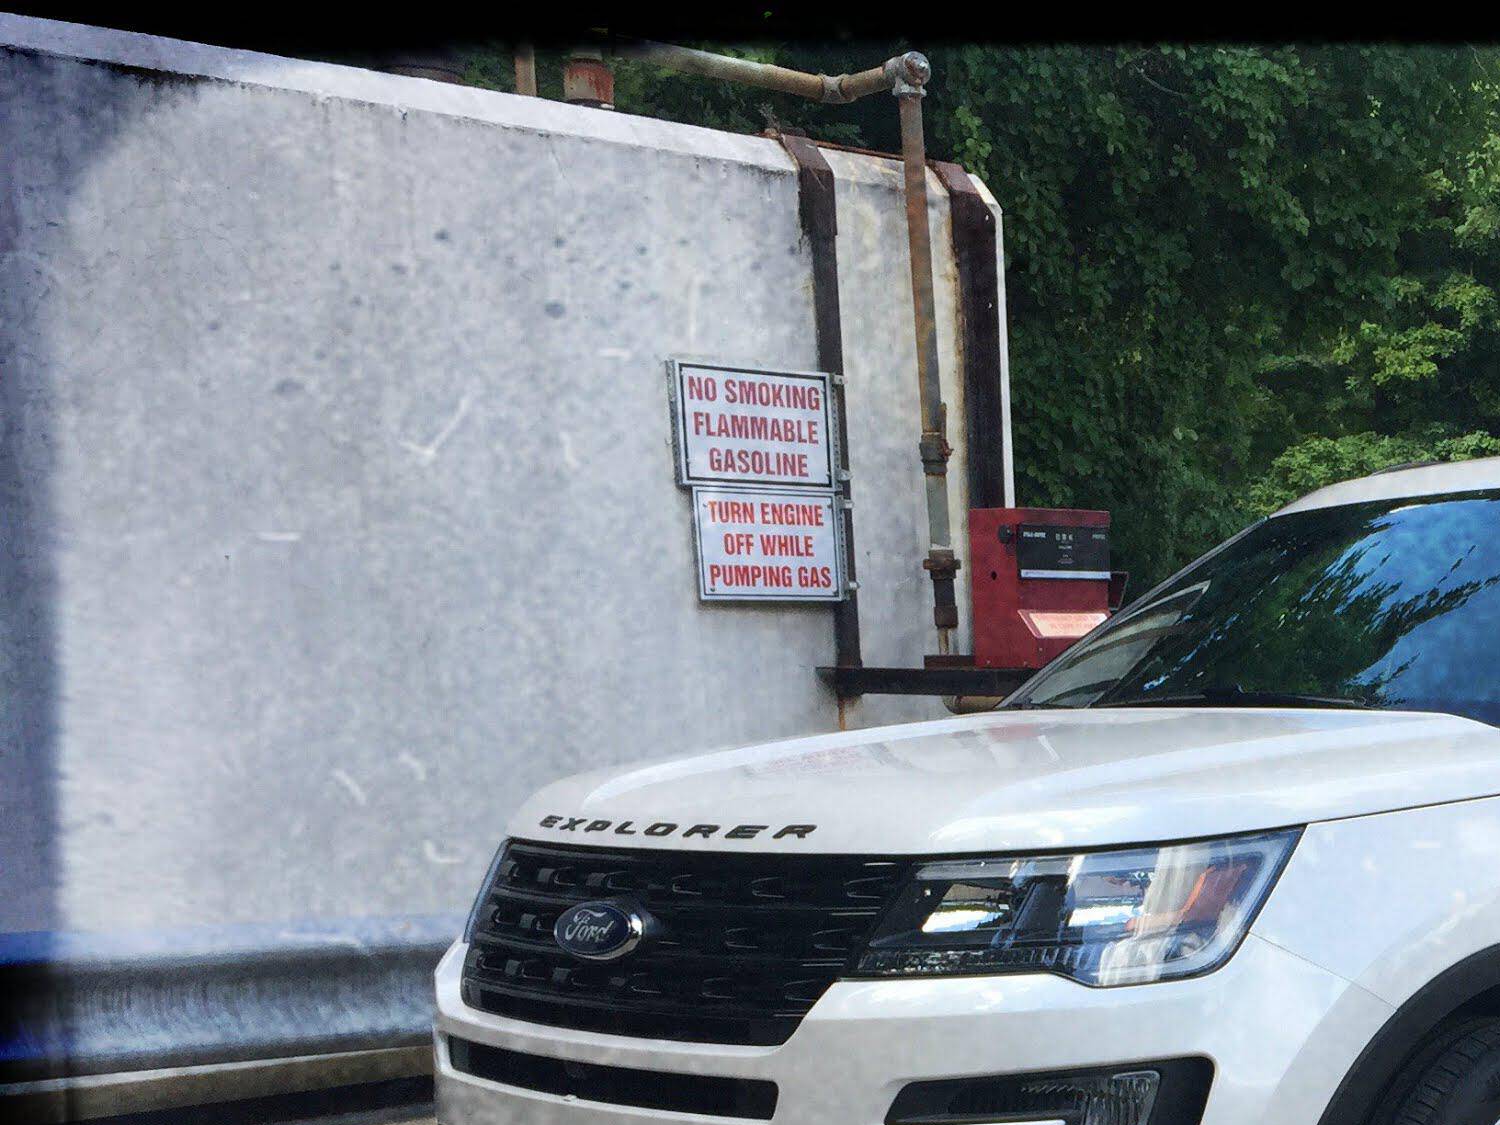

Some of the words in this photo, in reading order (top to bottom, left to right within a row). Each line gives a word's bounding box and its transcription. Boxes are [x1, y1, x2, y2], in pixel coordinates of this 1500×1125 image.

[688, 375, 717, 401] NO
[724, 379, 820, 411] SMOKING
[693, 411, 819, 444] FLAMMABLE
[709, 447, 809, 477] GASOLINE
[708, 500, 755, 524] TURN
[760, 502, 824, 527] ENGINE
[724, 533, 754, 556] OFF
[760, 535, 814, 557] WHILE
[709, 564, 793, 588] PUMPING
[797, 566, 832, 588] GAS
[539, 815, 818, 839] EXPLORER
[564, 908, 615, 942] Ford
